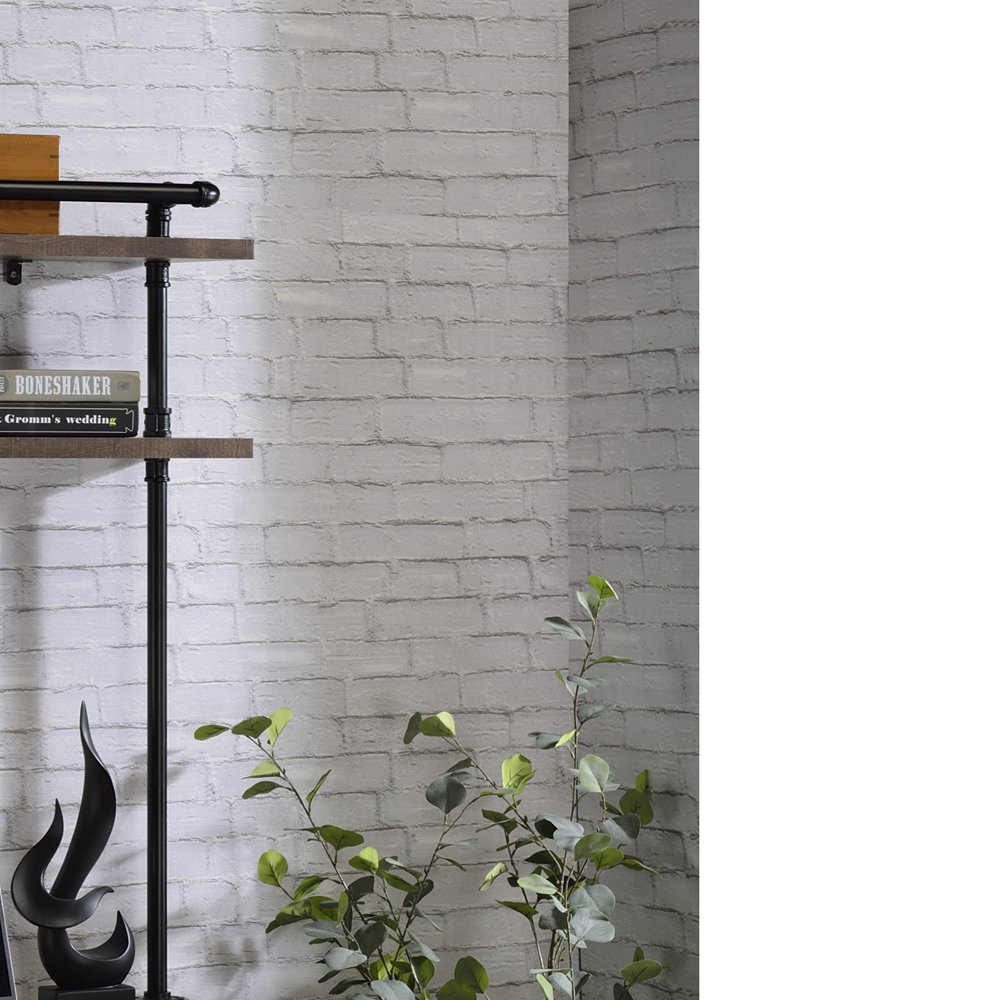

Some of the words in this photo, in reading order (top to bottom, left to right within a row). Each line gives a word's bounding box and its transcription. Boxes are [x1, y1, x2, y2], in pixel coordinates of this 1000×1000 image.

[15, 375, 111, 396] BONESHAKER
[4, 413, 61, 424] Gromm's
[66, 414, 117, 426] wedding
